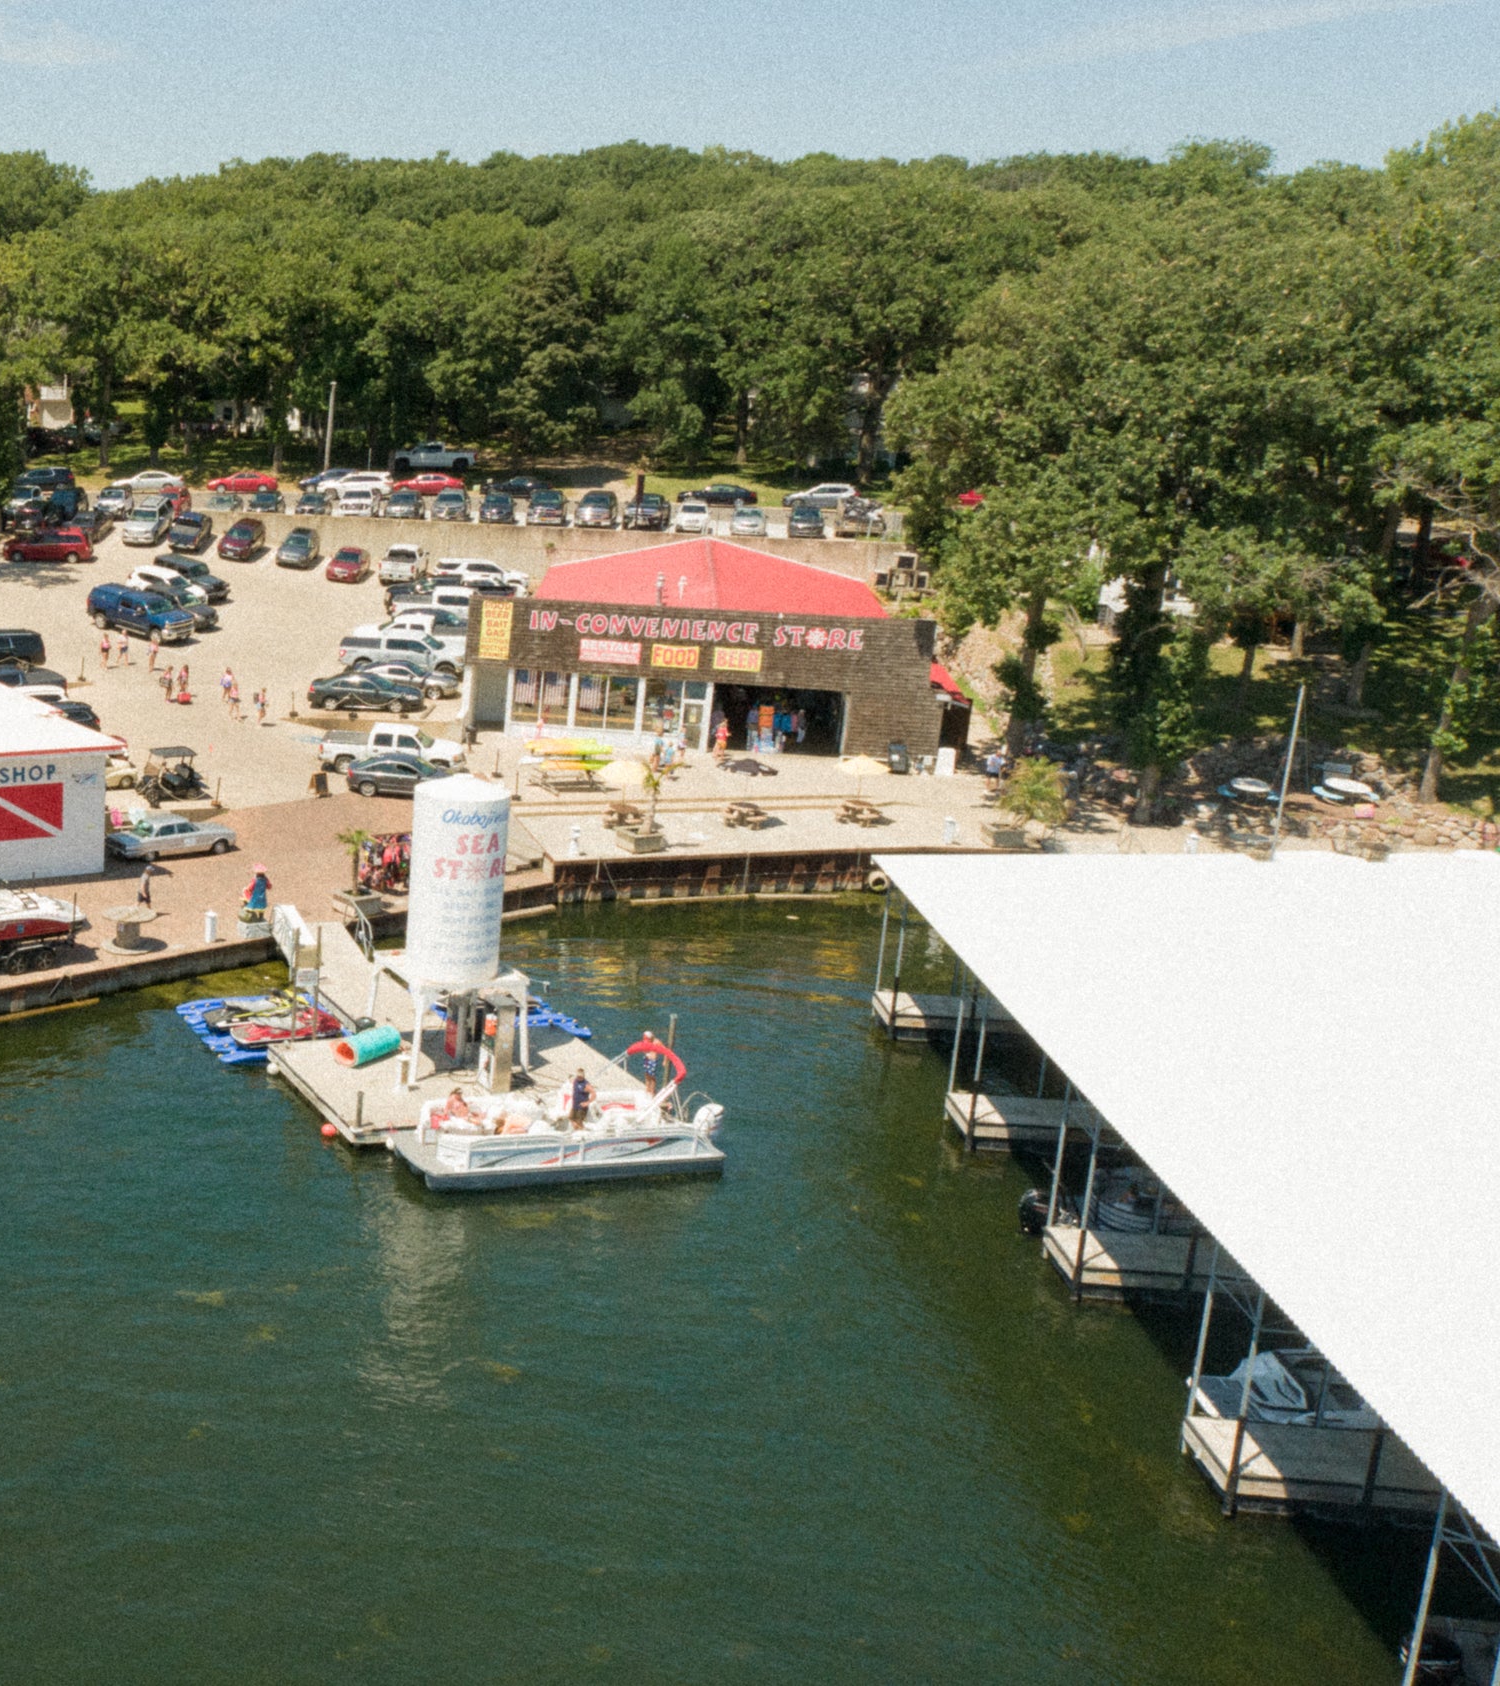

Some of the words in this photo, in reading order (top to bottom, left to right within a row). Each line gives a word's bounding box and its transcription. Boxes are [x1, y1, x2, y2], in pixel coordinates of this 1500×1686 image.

[486, 629, 505, 637] GAS
[529, 610, 759, 645] IN-CONVENIENCE
[652, 646, 698, 667] FOOD
[715, 650, 759, 670] BEER
[0, 764, 56, 783] SHOP
[455, 832, 500, 856] SEA
